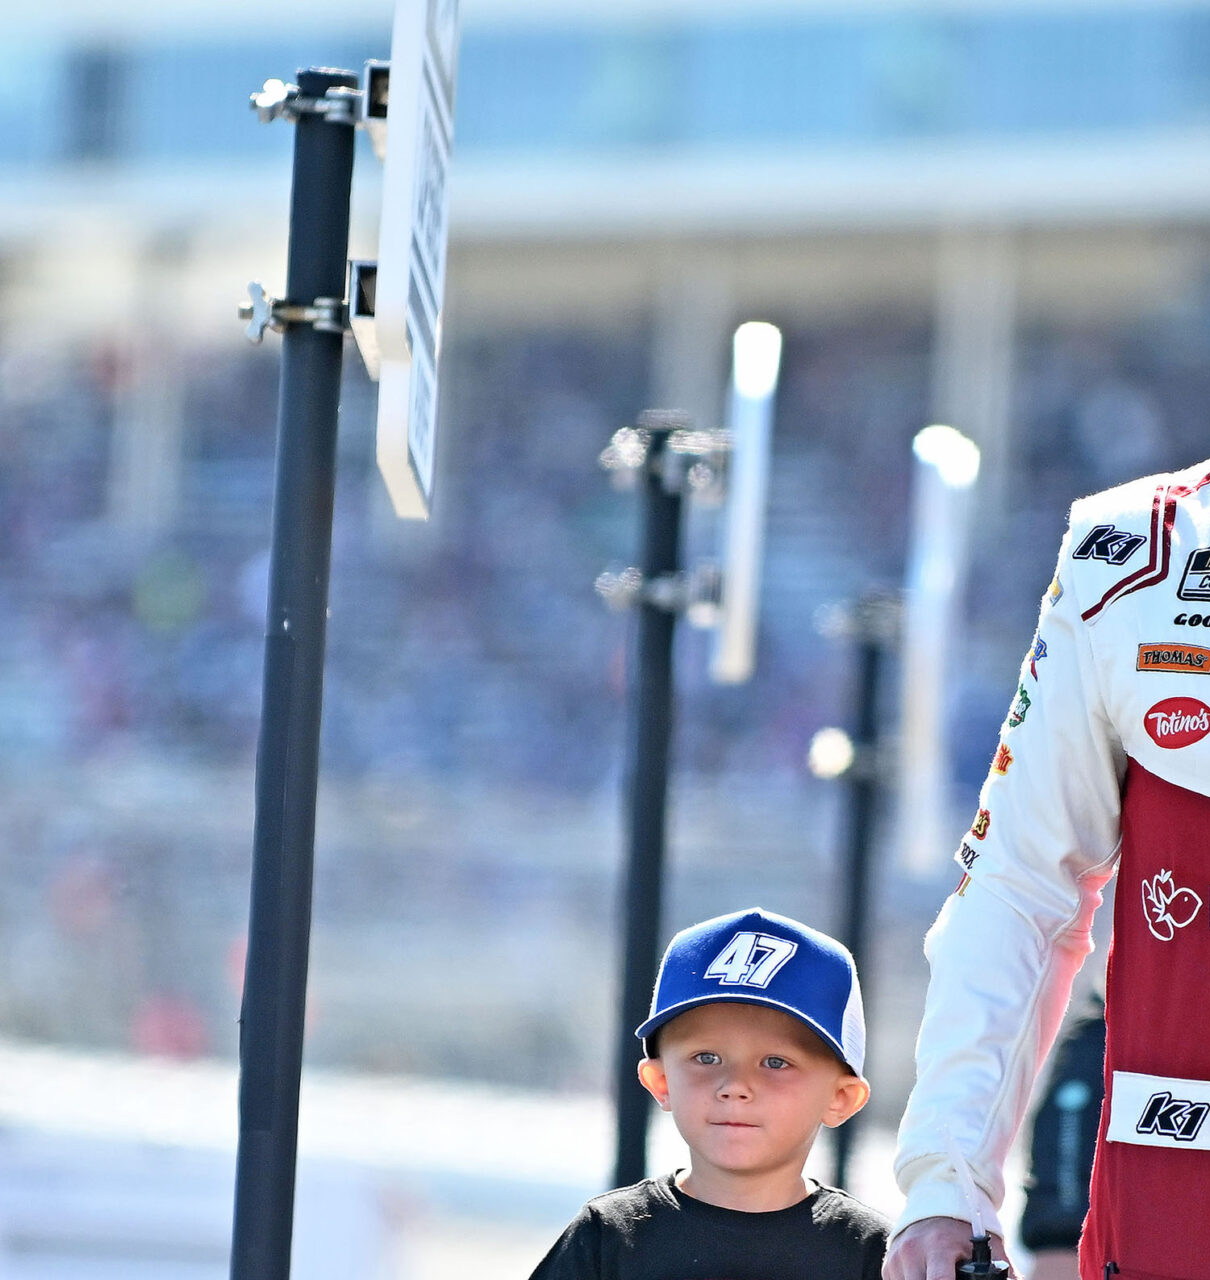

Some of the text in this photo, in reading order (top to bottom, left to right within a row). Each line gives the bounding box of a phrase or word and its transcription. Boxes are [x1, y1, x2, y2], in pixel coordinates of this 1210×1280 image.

[1072, 525, 1147, 565] K1
[1148, 708, 1210, 739] Totino's
[704, 931, 798, 989] 47
[1136, 1091, 1210, 1141] K1
